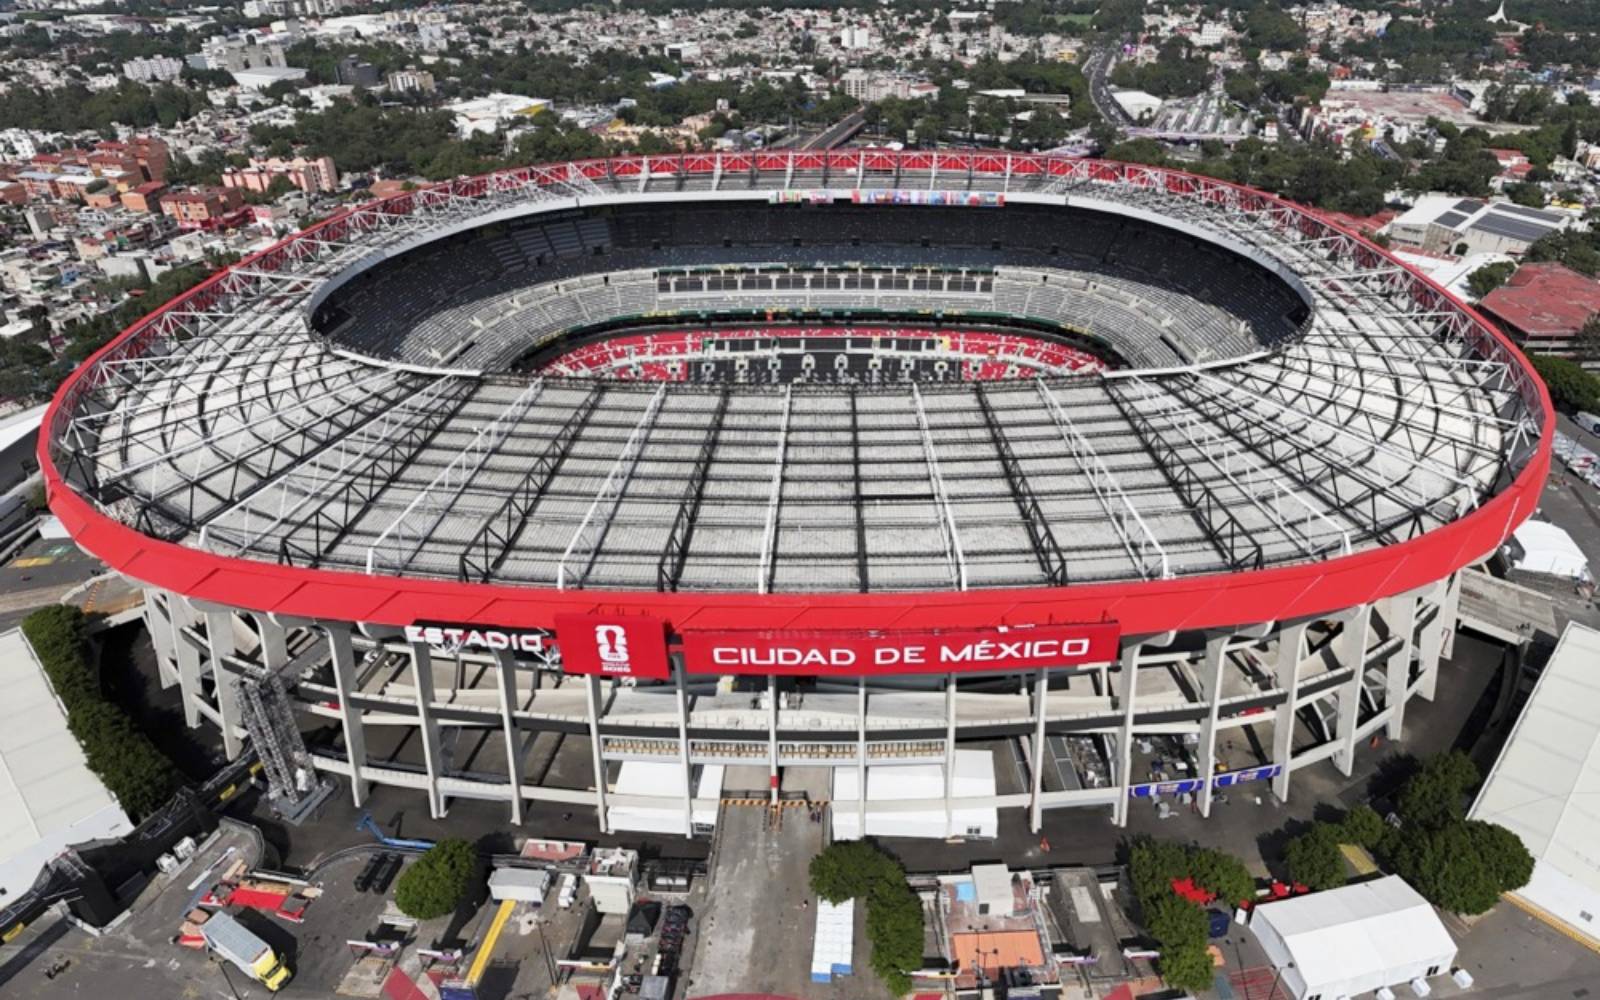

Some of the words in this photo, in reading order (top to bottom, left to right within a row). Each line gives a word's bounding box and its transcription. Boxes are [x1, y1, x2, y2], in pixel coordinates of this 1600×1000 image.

[404, 625, 543, 652] ESTADIO
[712, 647, 856, 666] CIUDAD
[874, 646, 926, 665] DE
[940, 638, 1091, 663] MÉXICO
